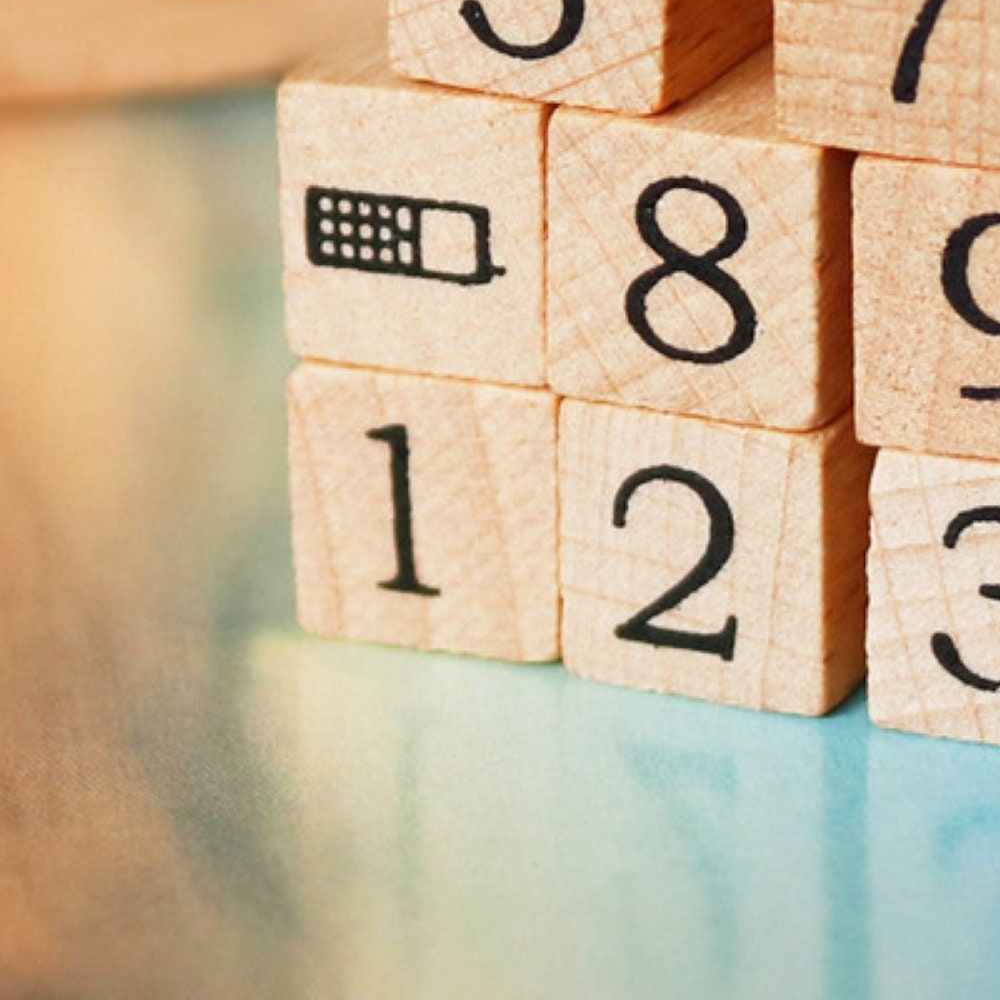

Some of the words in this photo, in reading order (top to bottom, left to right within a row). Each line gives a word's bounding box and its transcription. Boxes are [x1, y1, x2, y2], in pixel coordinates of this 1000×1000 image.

[626, 176, 757, 364] 8
[366, 426, 440, 597] 1
[613, 465, 737, 661] 2
